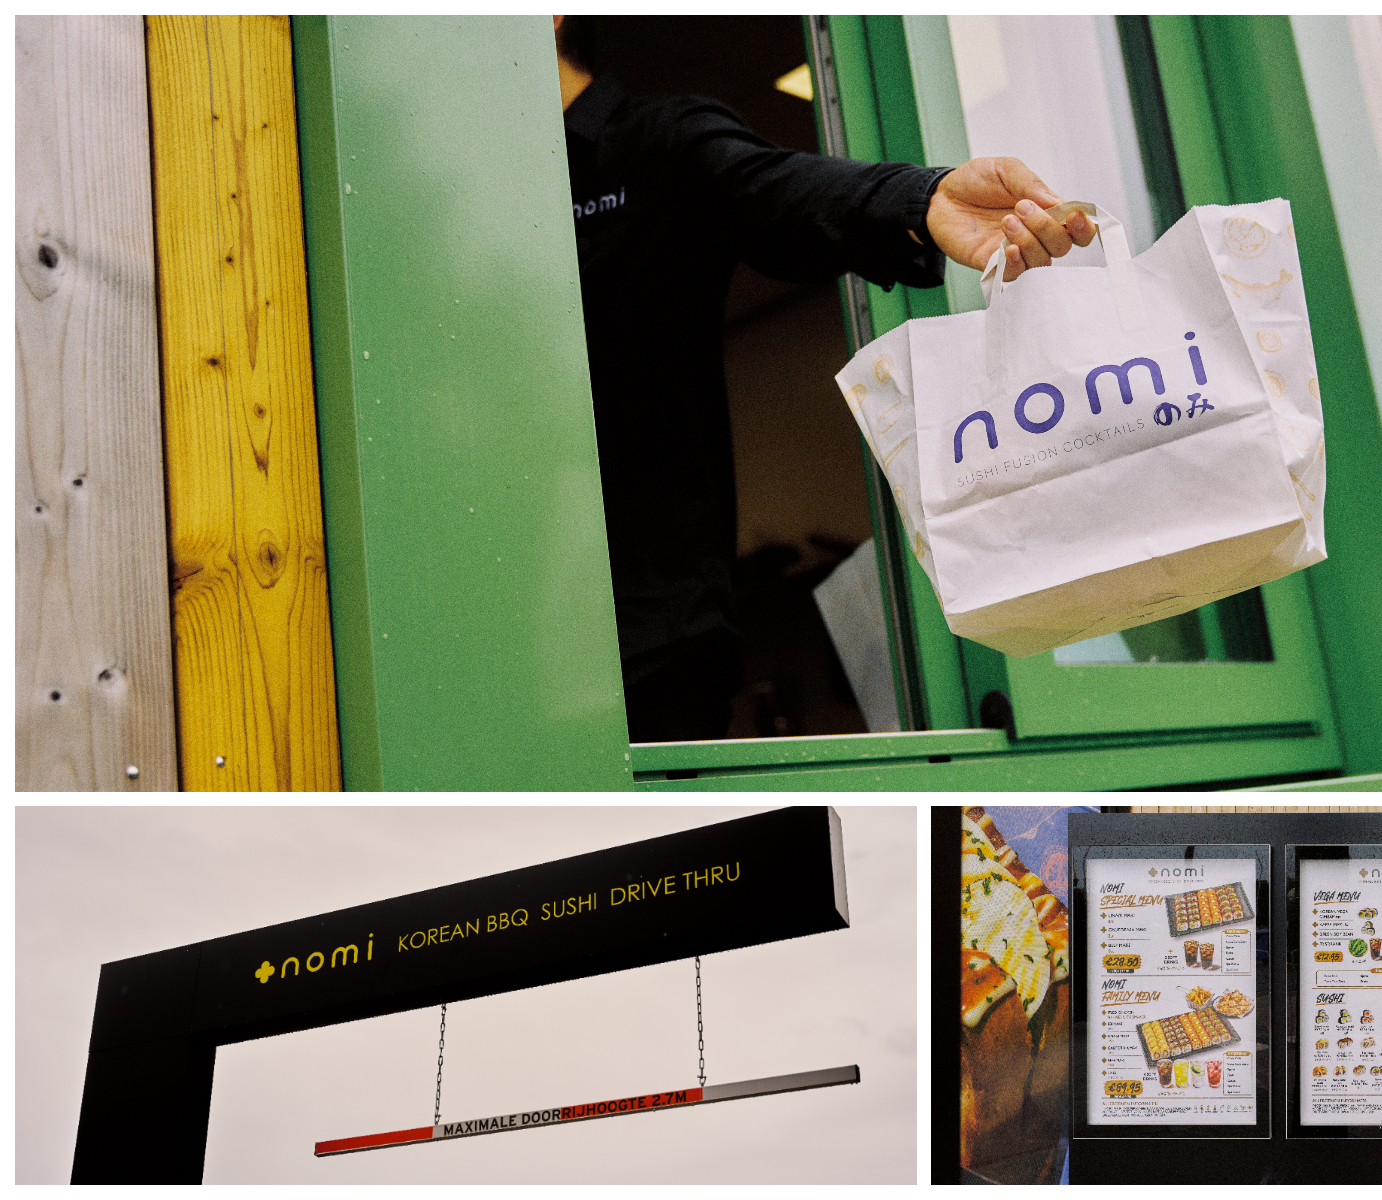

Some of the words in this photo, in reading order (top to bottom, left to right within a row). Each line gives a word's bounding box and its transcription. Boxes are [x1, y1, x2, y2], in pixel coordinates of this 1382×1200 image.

[573, 186, 625, 219] nomi
[953, 331, 1208, 463] nomi
[956, 465, 999, 487] SUSHI
[1003, 446, 1058, 472] FUSION
[1062, 418, 1146, 454] COCKTAILS
[1161, 865, 1204, 877] nomi
[1100, 883, 1125, 894] NOMI
[1100, 895, 1136, 906] SPECIAL
[1138, 896, 1164, 906] MENU
[1313, 890, 1337, 902] VEGA
[1337, 890, 1361, 901] MENU
[281, 932, 374, 979] nomi
[398, 918, 480, 953] KOREAN
[486, 908, 529, 934] BBQ
[541, 892, 597, 921] SUSHI
[610, 875, 677, 906] DRIVE
[682, 861, 742, 890] THRU
[1105, 956, 1139, 967] €28.50
[1102, 979, 1127, 990] NOMI
[1102, 991, 1134, 1002] FAMILY
[1135, 991, 1161, 1002] MENU
[1316, 993, 1345, 1003] SUSHI
[1108, 1080, 1141, 1094] €89.95
[443, 1114, 517, 1136] MAXIMALE
[521, 1097, 647, 1124] DOORRIJHOOGTE
[652, 1090, 687, 1107] 2.7M
